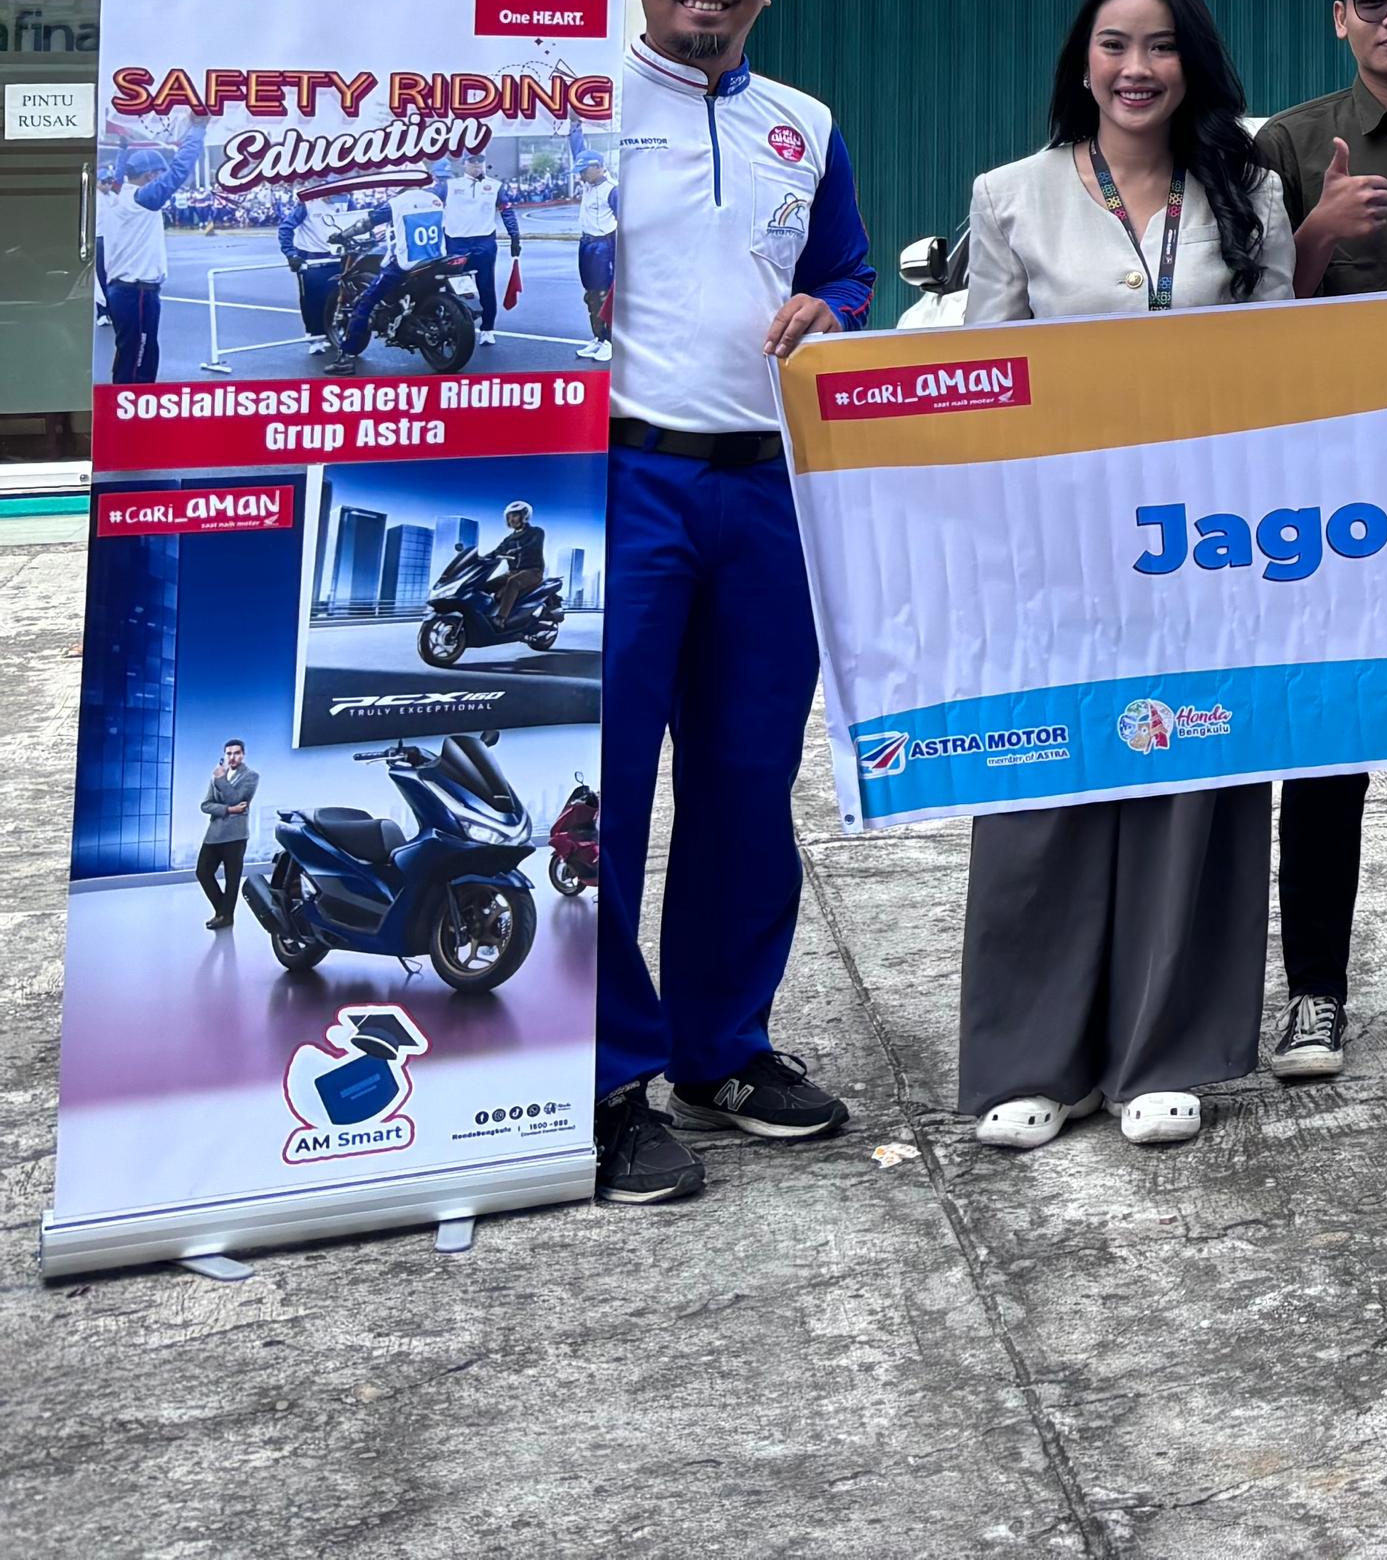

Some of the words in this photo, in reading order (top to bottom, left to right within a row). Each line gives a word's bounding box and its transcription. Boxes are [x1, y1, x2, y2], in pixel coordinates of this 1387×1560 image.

[499, 9, 529, 26] One
[531, 10, 585, 27] HEART.
[22, 94, 74, 107] PINTU
[112, 66, 377, 117] SAFETY
[389, 72, 613, 121] RIDING
[18, 114, 78, 127] RUSAK
[217, 114, 492, 192] Education
[413, 225, 439, 246] 09
[116, 384, 311, 421] Sosialisasi
[321, 380, 430, 418] Safety
[439, 378, 542, 414] Riding
[553, 378, 585, 406] to
[264, 421, 345, 453] Grup
[355, 415, 446, 447] Astra
[350, 708, 391, 717] TRULY
[400, 703, 492, 715] EXCEPTIONAL
[1175, 705, 1232, 726] Honda
[1178, 724, 1230, 737] Bengkulu
[911, 736, 981, 758] ASTRA
[987, 727, 1067, 750] MOTOR
[1036, 750, 1068, 760] ASTRA
[295, 1132, 331, 1154] AM
[338, 1124, 403, 1148] Smart
